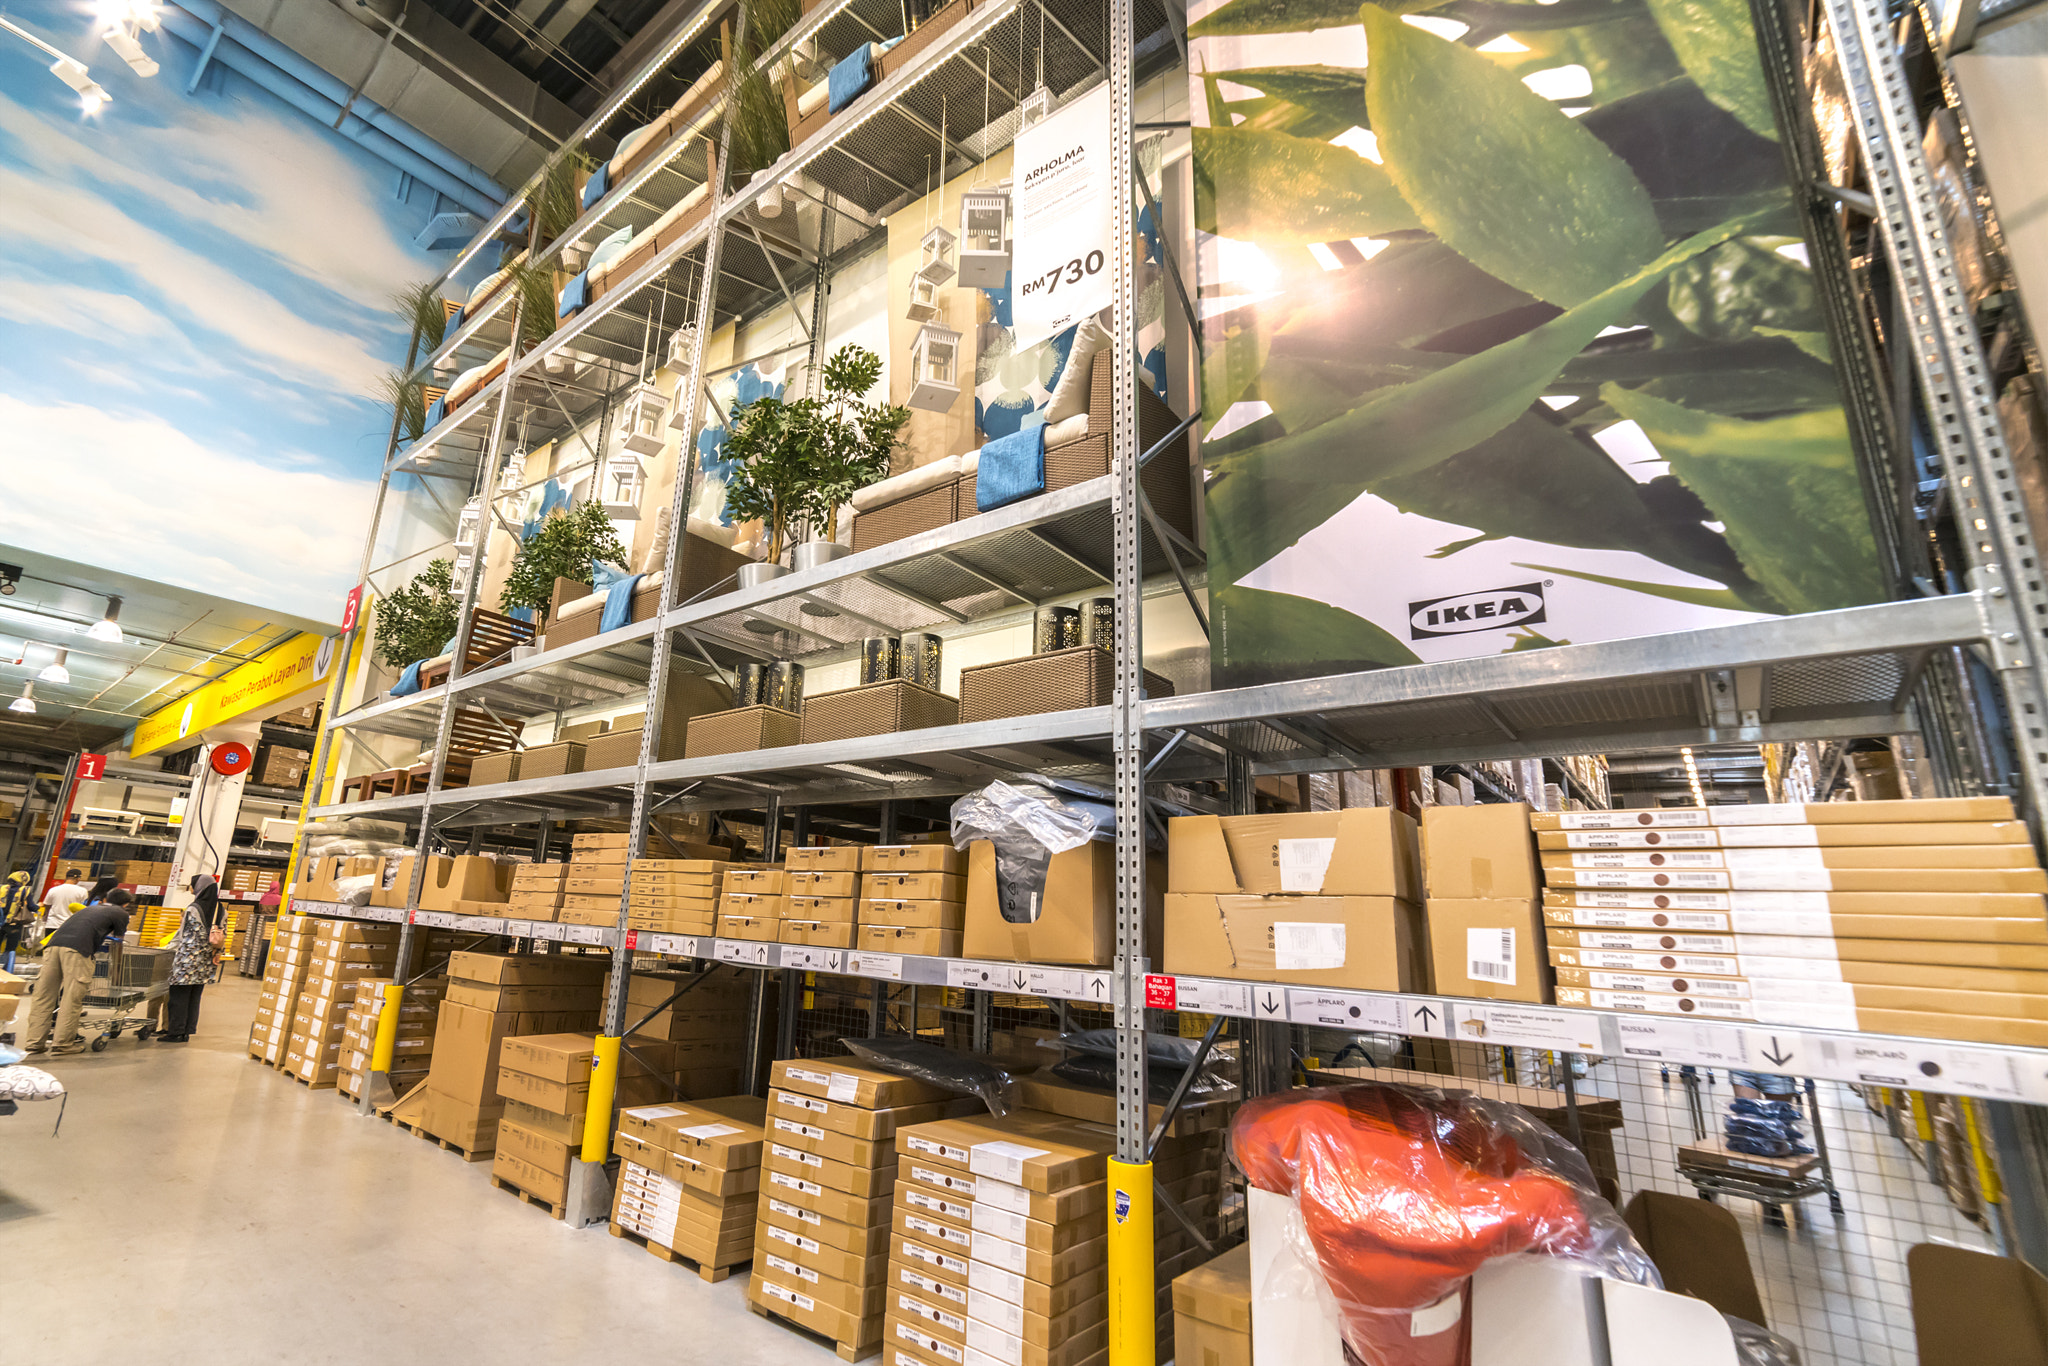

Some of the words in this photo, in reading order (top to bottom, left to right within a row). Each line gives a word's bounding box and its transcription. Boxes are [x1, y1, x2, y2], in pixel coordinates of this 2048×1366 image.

[1025, 145, 1085, 183] ARHOLMA
[344, 599, 356, 629] 3
[1427, 597, 1529, 626] IKEA
[220, 687, 247, 709] Kawasan
[246, 672, 273, 696] Perabot
[274, 663, 296, 686] Layan
[297, 650, 315, 673] Diri
[83, 761, 95, 777] 1
[1148, 983, 1173, 991] Bahagian
